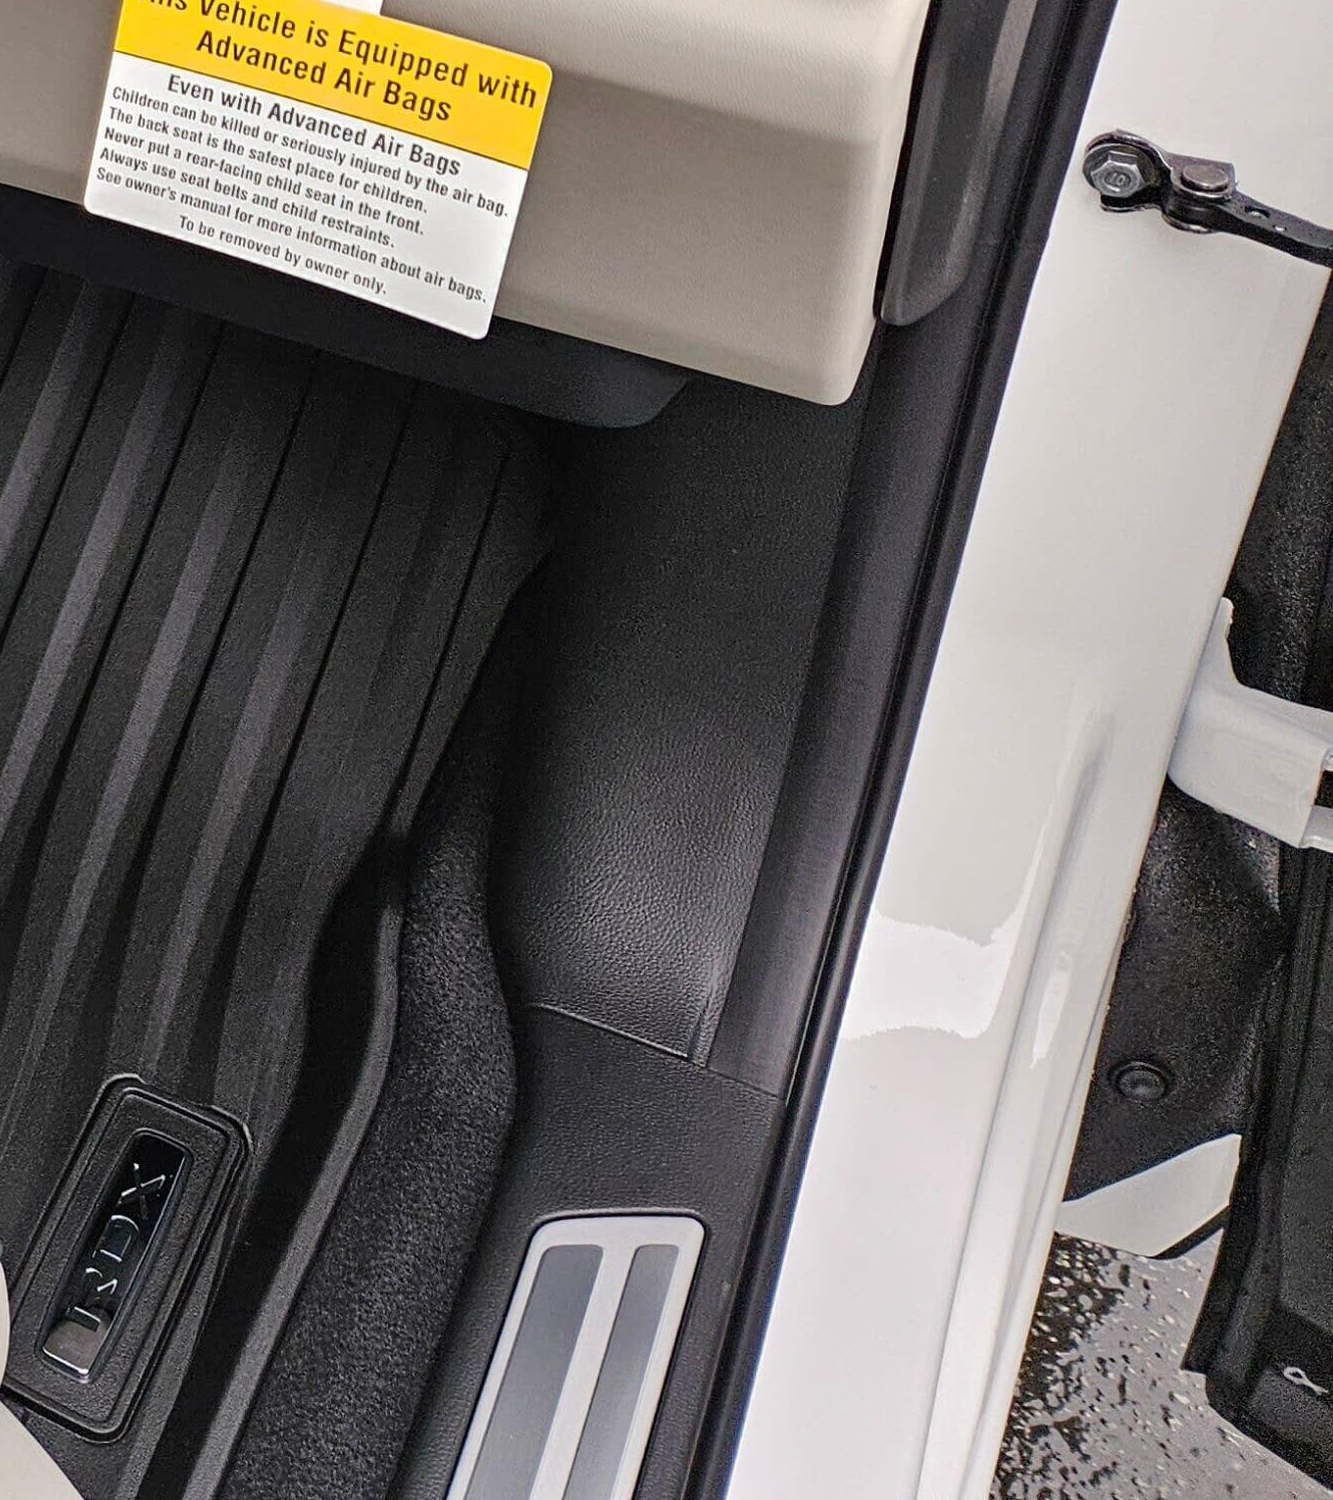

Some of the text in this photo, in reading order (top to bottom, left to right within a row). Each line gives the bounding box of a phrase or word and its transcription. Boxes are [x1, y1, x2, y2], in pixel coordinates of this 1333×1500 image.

[195, 29, 451, 121] Advanced Air Bags
[305, 19, 329, 47] is
[338, 28, 468, 87] Equipped
[478, 73, 536, 108] with
[109, 106, 426, 213] The back seat is the safest place for children.
[112, 86, 507, 216] Children can be killed or seriously injured by the air bag.
[167, 73, 460, 175] Even with Advanced Air Bags
[99, 147, 394, 247] Always use seat belts and child restraints.
[104, 126, 423, 235] Never put a rear-facing child seat in the front.
[96, 166, 485, 303] See owner's manual for more information about air bags.
[179, 214, 386, 294] To be removed by owner only.
[66, 1163, 169, 1333] RDX
